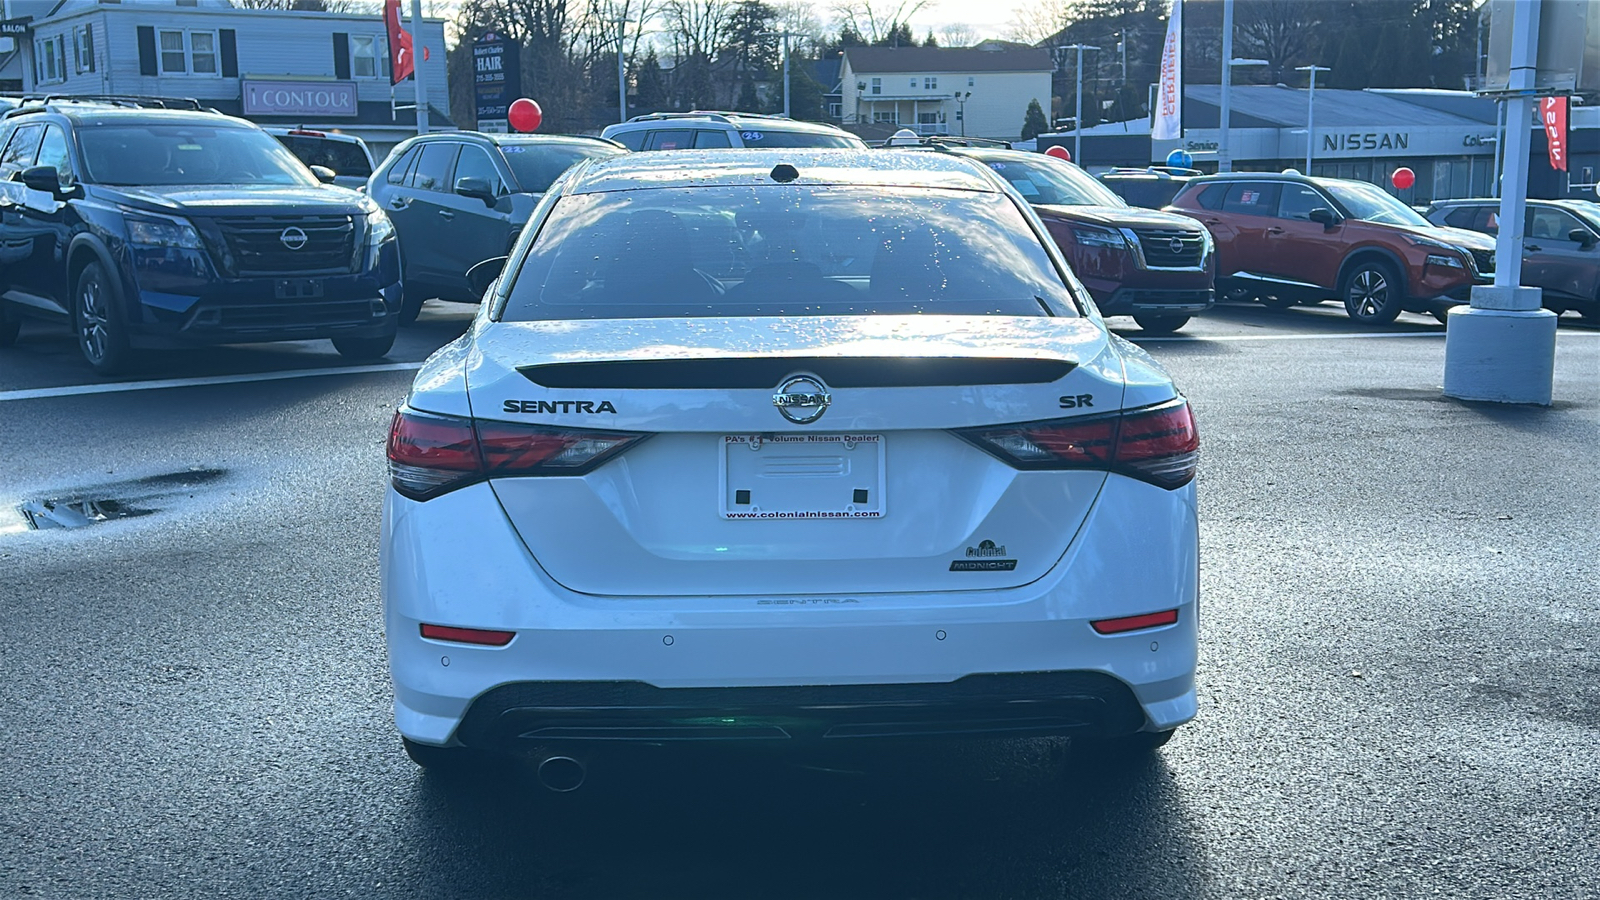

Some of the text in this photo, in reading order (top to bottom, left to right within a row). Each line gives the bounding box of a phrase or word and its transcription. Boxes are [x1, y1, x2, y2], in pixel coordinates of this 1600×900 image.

[2, 24, 26, 33] SALON
[477, 56, 502, 71] HAIR
[262, 90, 349, 108] CONTOUR
[1187, 141, 1219, 150] Service
[1323, 133, 1409, 151] NISSAN
[503, 399, 617, 414] SENTRA
[779, 395, 826, 404] NISSAN
[1059, 393, 1094, 409] SR
[966, 545, 1007, 558] Colonial
[953, 562, 1014, 570] MIDNIGHT
